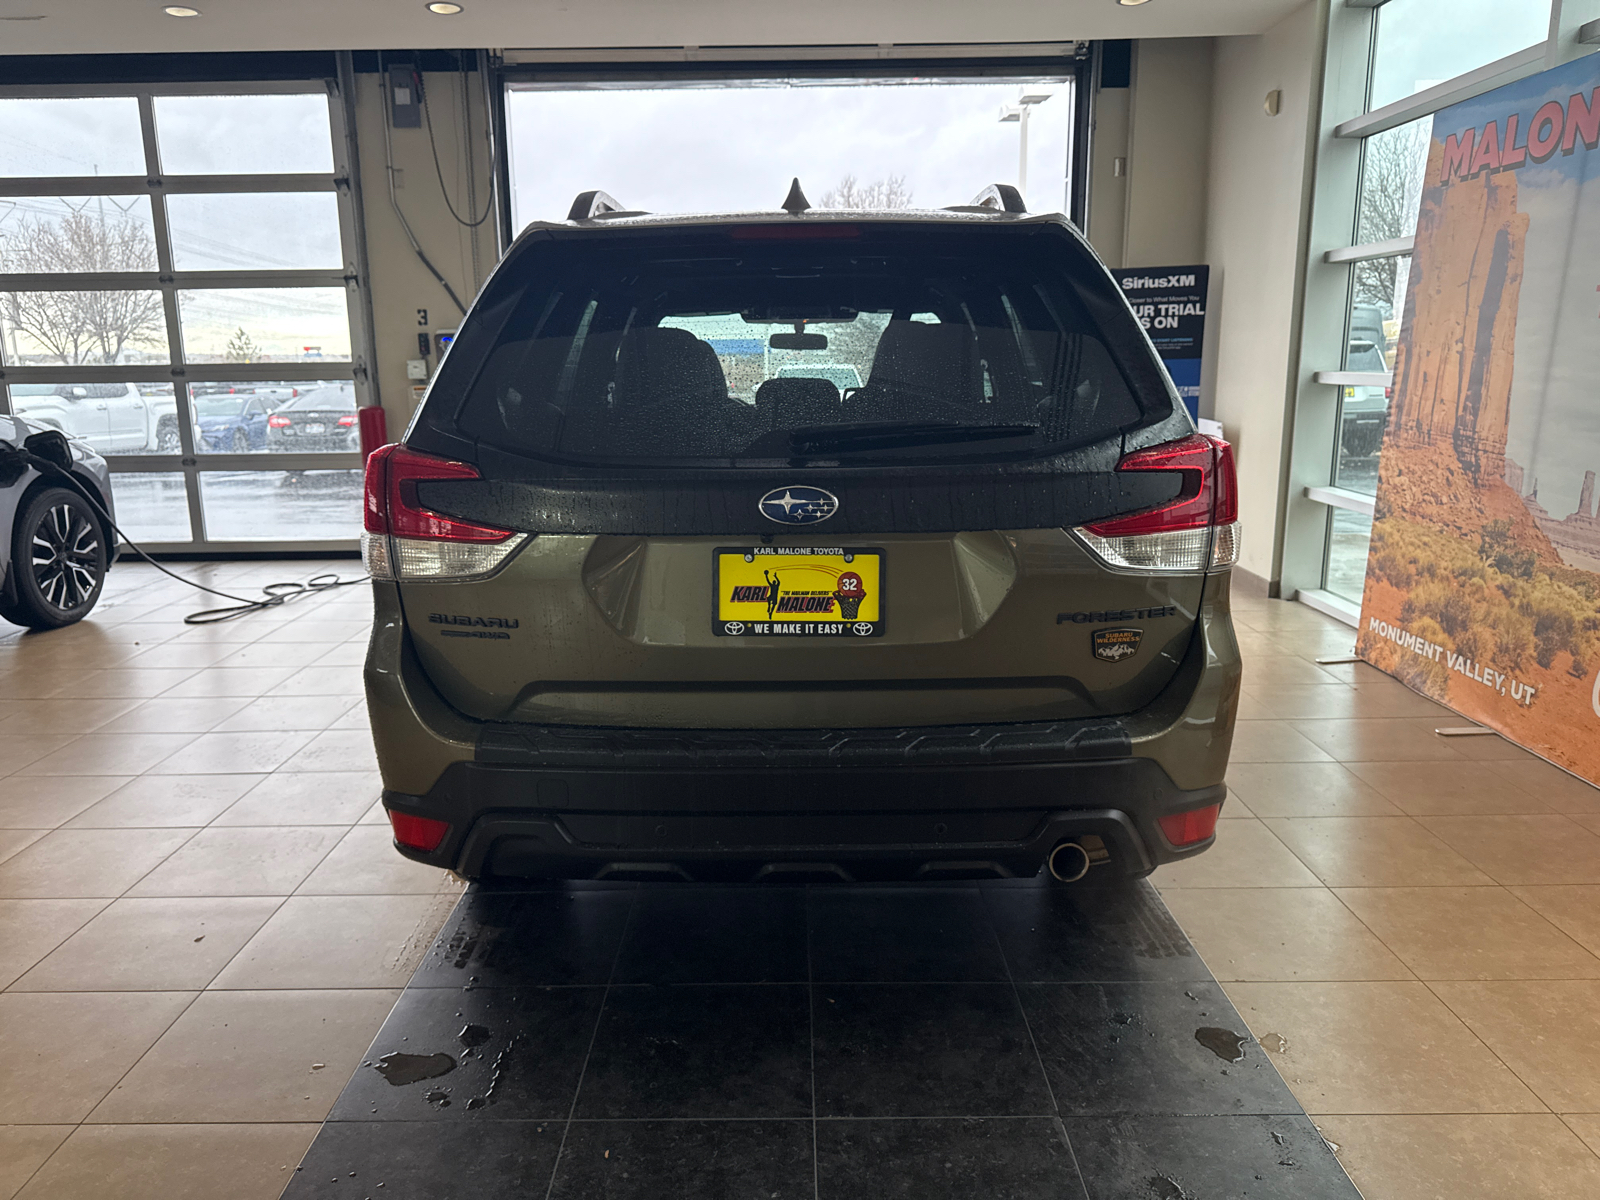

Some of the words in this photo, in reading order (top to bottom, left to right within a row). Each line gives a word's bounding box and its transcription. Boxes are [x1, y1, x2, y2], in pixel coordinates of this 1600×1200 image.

[1440, 86, 1600, 187] MALON
[1122, 275, 1195, 289] SiriusXM
[1158, 303, 1205, 316] TRIAL
[417, 309, 428, 326] 3
[1140, 317, 1151, 329] S
[1153, 316, 1179, 329] ON
[754, 547, 776, 555] KARL
[777, 547, 812, 555] MALONE
[813, 547, 844, 555] TOYOTA
[842, 578, 857, 591] 32
[730, 586, 770, 602] KARL
[776, 596, 834, 613] MALONE
[428, 613, 519, 629] SUBARU
[1056, 604, 1177, 625] FORESTER
[754, 624, 769, 634] WE
[773, 624, 802, 634] MAKE
[805, 624, 814, 634] IT
[818, 624, 843, 634] EASY
[1097, 636, 1140, 644] WILDERNESS
[1369, 616, 1443, 662] MONUMENT
[1446, 650, 1505, 697] VALLEY,
[1510, 679, 1536, 705] UT
